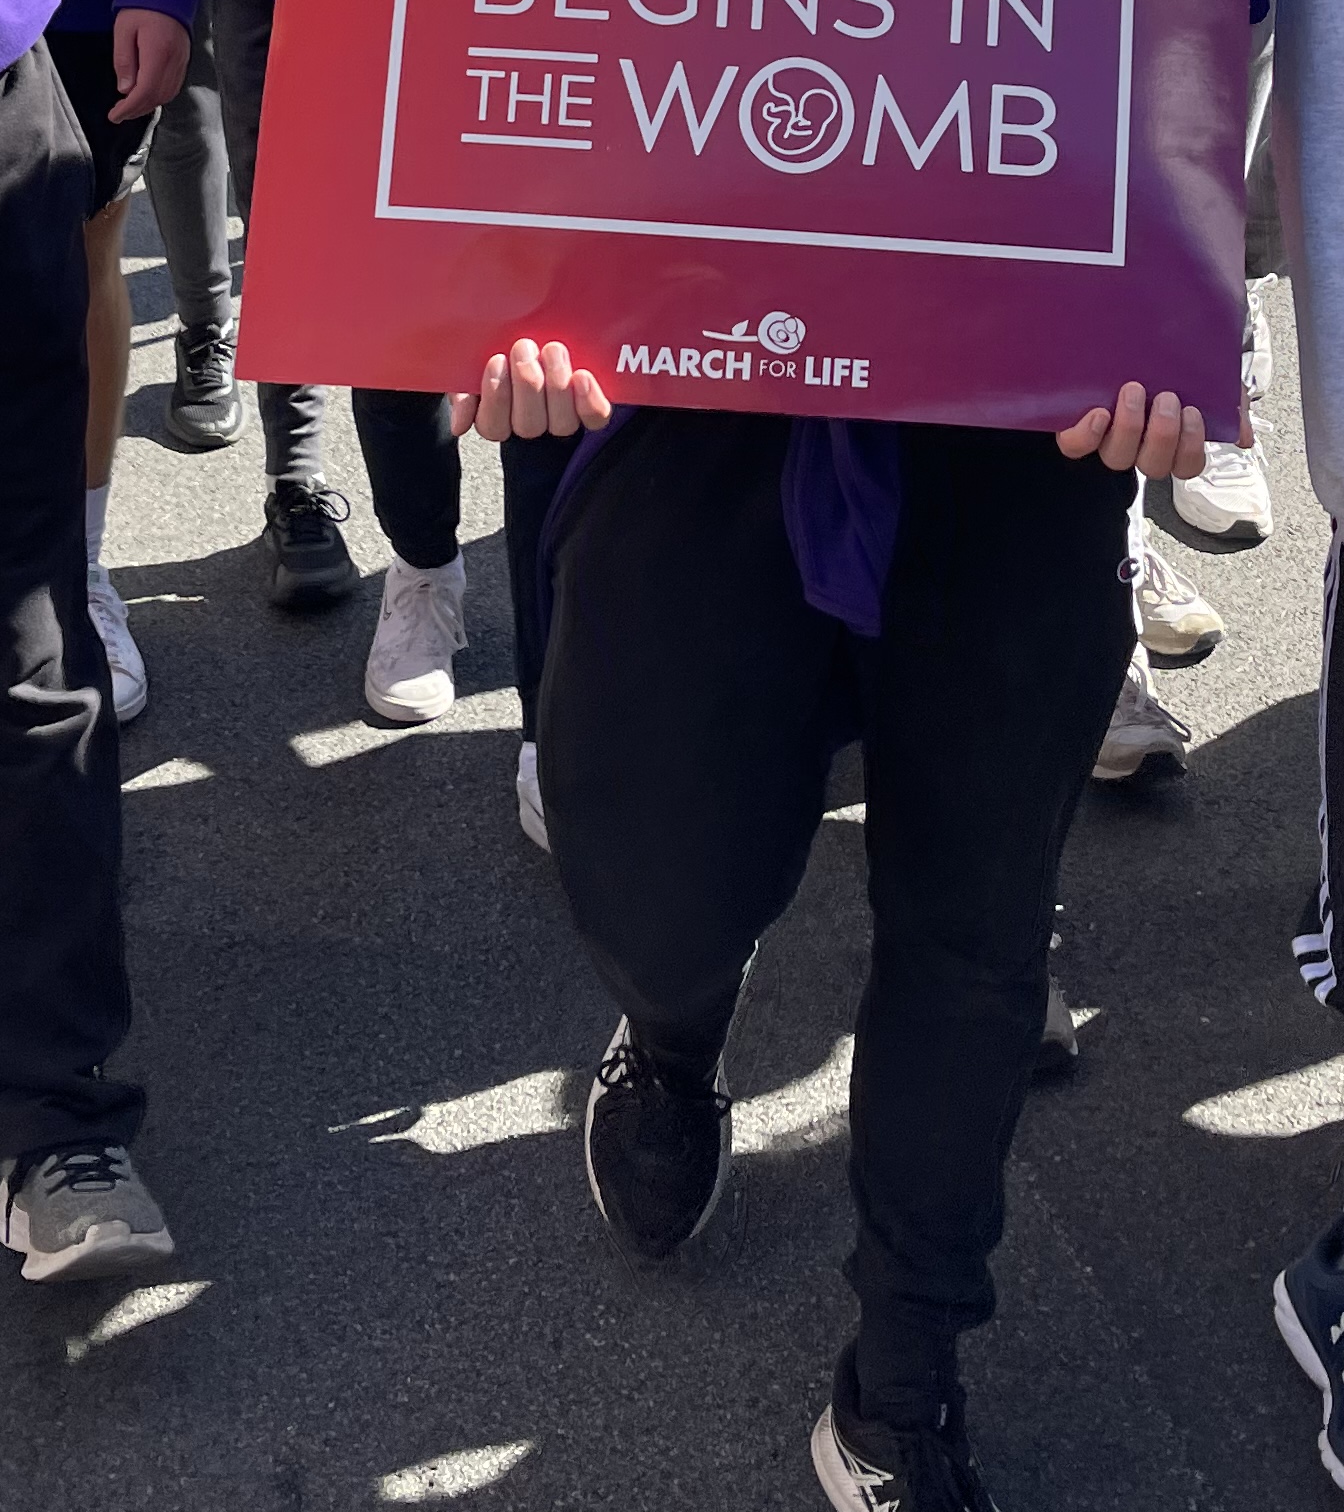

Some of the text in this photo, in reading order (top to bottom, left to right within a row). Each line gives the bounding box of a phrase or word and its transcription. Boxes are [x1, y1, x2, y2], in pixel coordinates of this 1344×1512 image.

[465, 55, 1060, 178] THE WOMB
[615, 342, 871, 390] MARCH FOR LIFE
